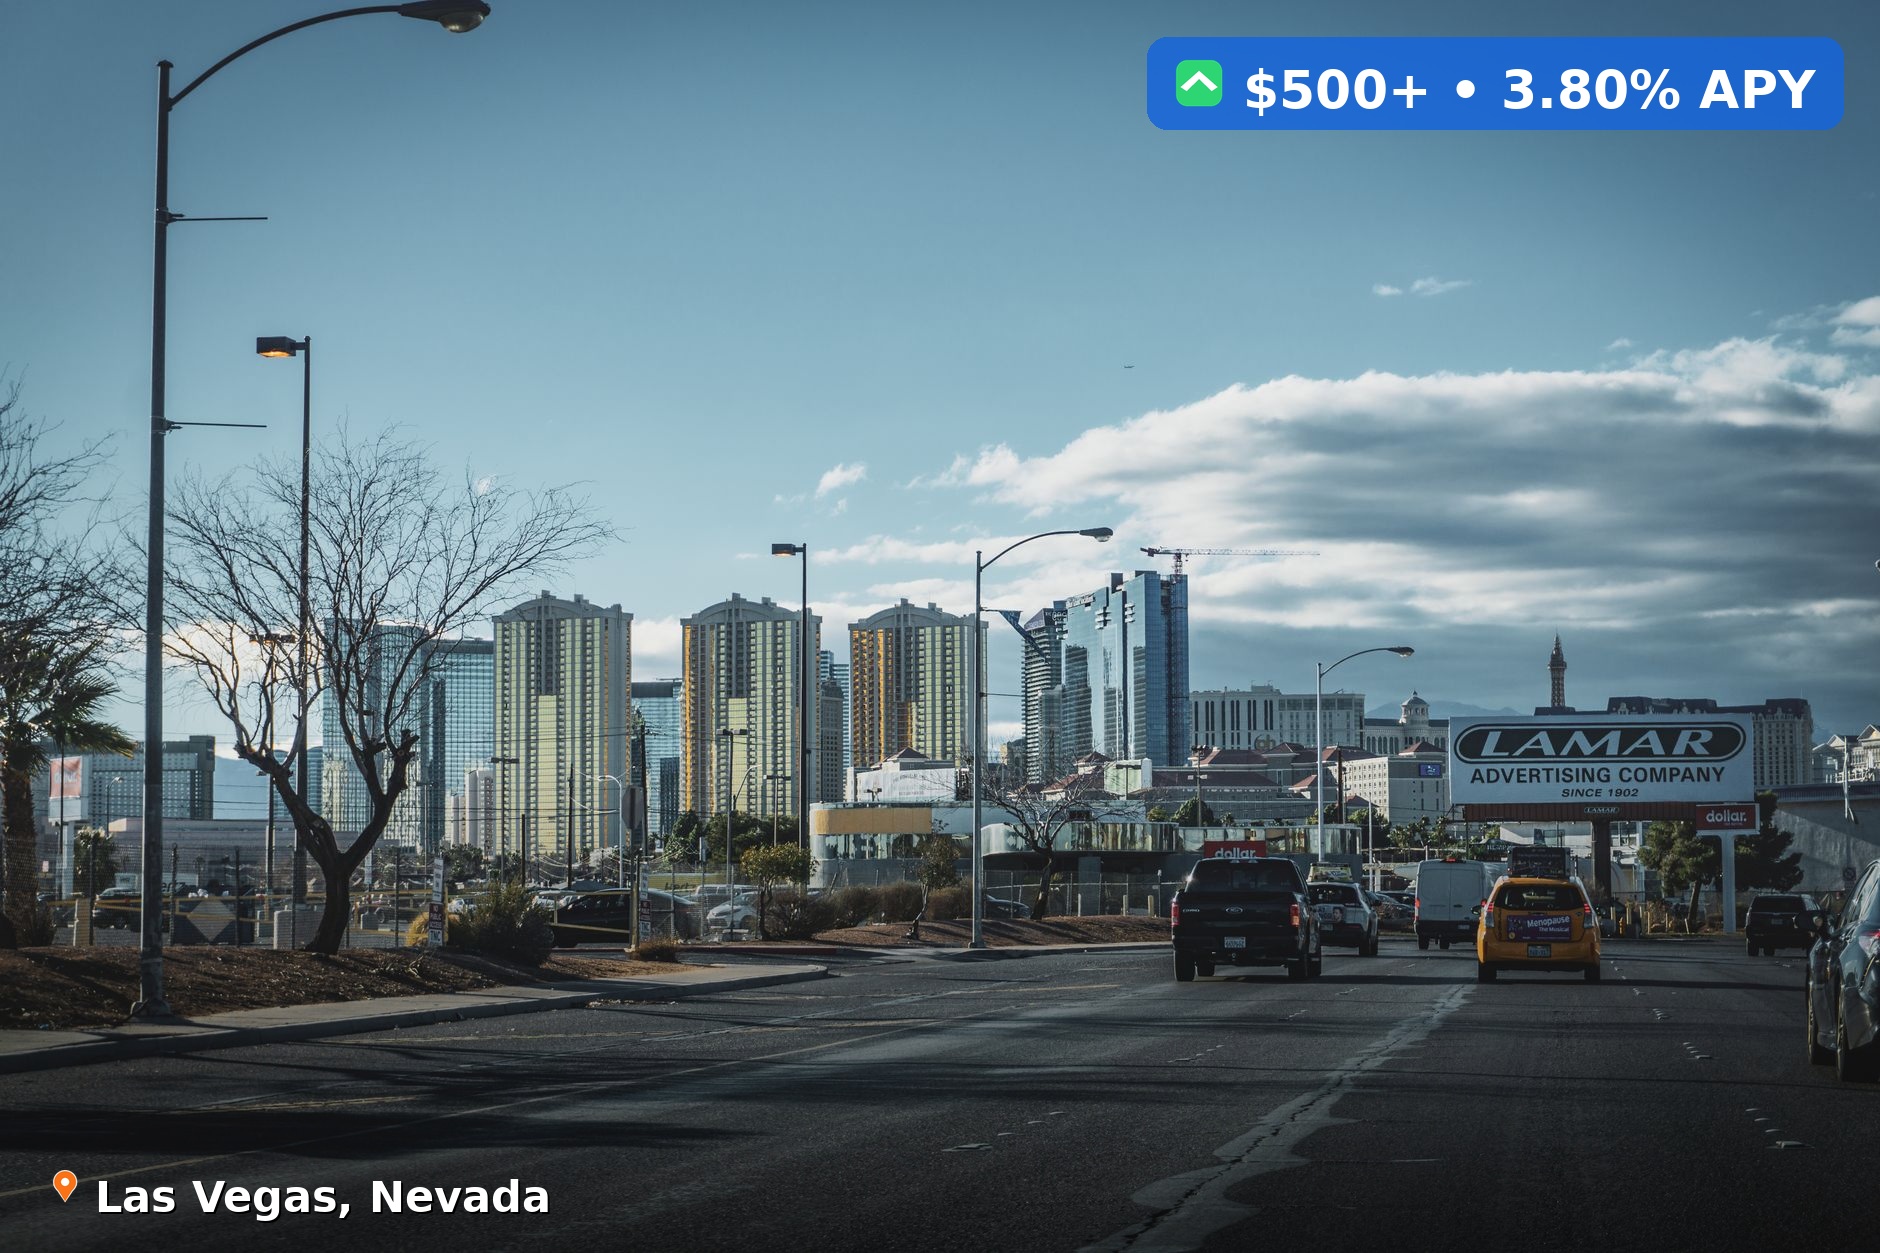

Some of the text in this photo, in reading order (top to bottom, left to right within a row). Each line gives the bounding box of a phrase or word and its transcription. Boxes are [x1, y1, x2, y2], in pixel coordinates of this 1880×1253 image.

[1480, 729, 1713, 757] LAMAR
[1470, 766, 1726, 784] ADVERTISING COMPANY
[1561, 788, 1639, 798] SINCE 1902
[1527, 915, 1570, 928] Menopause
